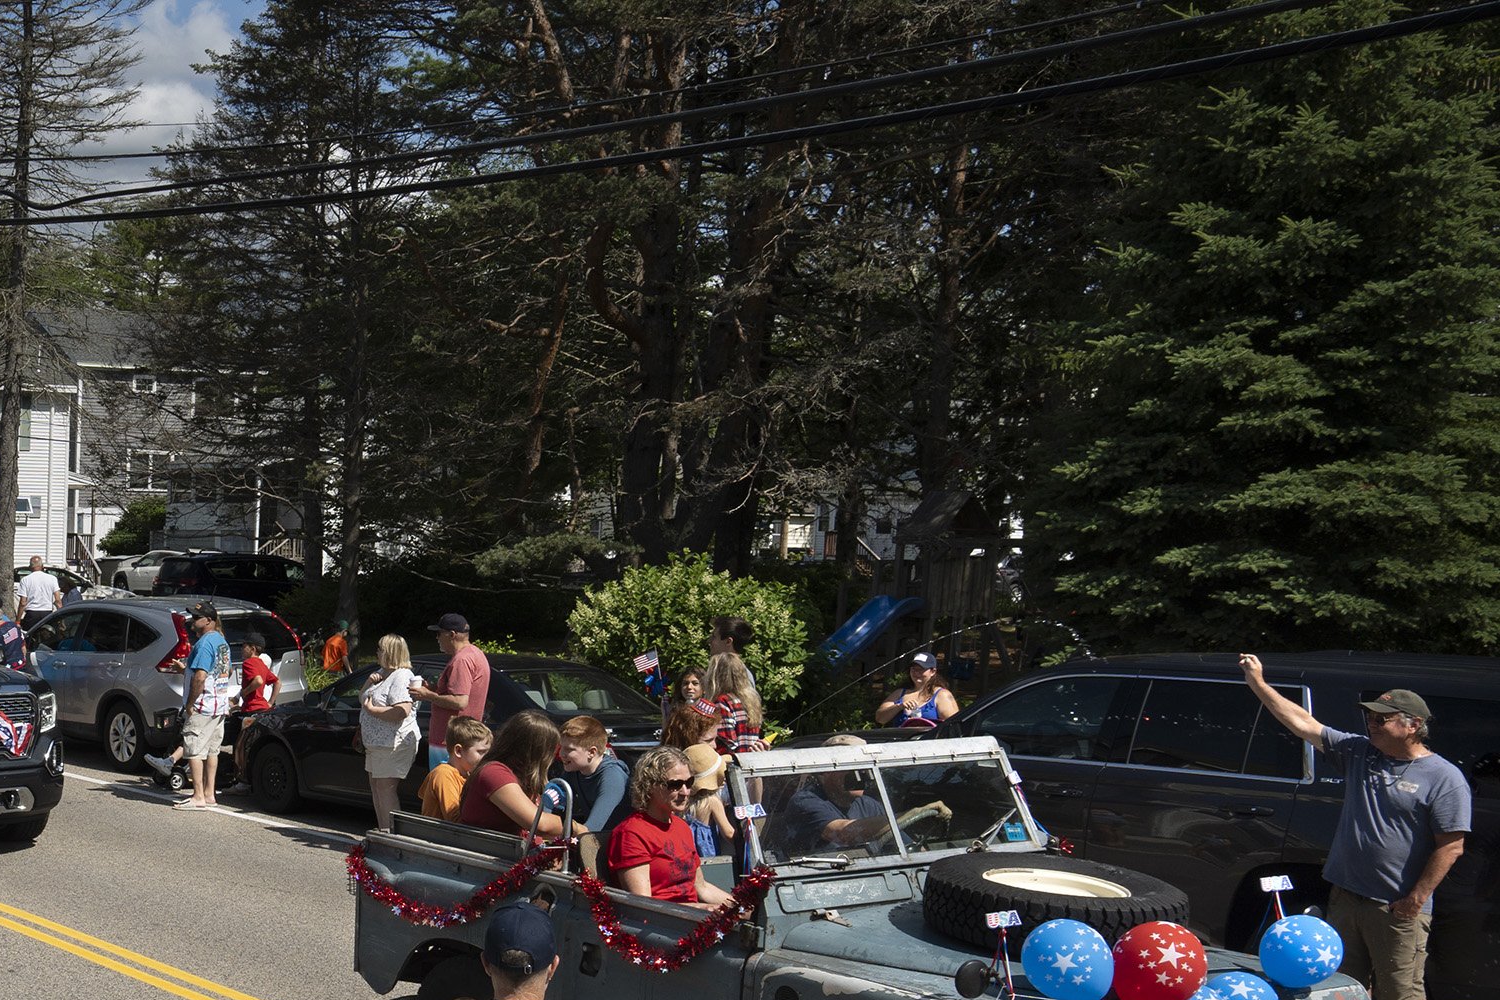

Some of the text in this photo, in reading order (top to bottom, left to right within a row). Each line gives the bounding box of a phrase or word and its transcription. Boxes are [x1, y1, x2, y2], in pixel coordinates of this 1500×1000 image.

[734, 803, 767, 820] USA
[1260, 874, 1294, 892] USA
[985, 910, 1022, 928] USA
